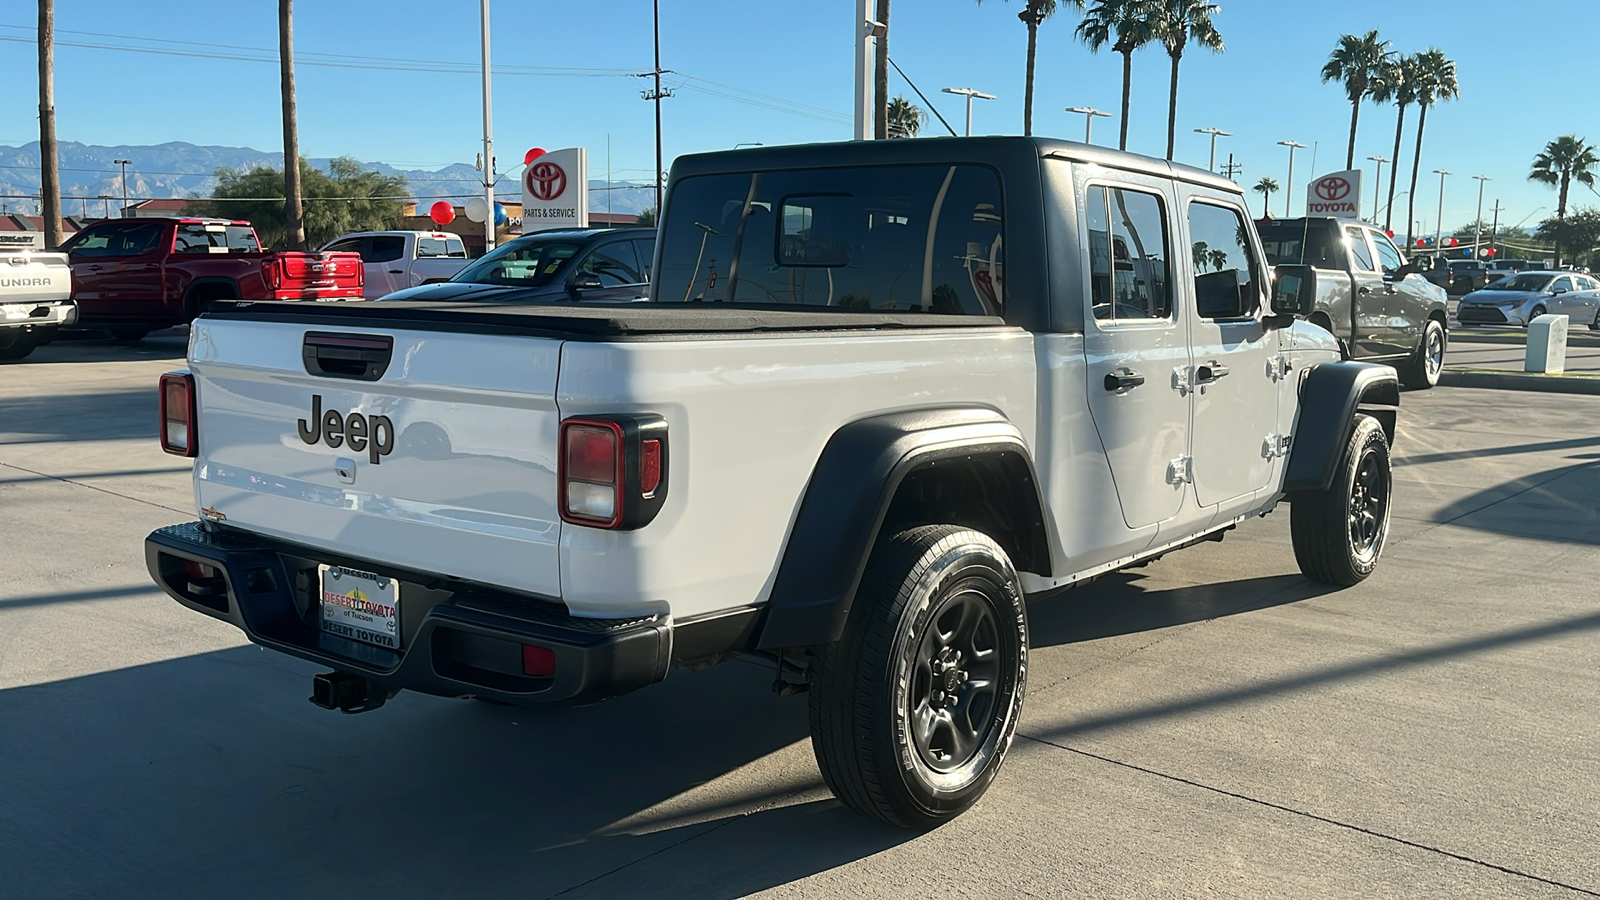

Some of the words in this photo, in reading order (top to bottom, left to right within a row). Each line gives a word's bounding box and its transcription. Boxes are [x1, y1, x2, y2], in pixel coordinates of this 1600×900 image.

[524, 208, 541, 218] PARTS
[542, 208, 548, 217] &
[548, 208, 576, 218] SERVICE
[1309, 202, 1356, 213] TOYOTA
[508, 216, 522, 226] PO
[0, 278, 52, 287] UNDRA
[297, 394, 395, 465] Jeep
[338, 567, 377, 580] TUCSON
[324, 592, 356, 608] DESERT
[360, 600, 396, 618] TOYOTA
[343, 609, 351, 617] of
[351, 611, 374, 623] Tucson
[323, 622, 353, 636] DESERT
[356, 630, 394, 647] TOYOTA
